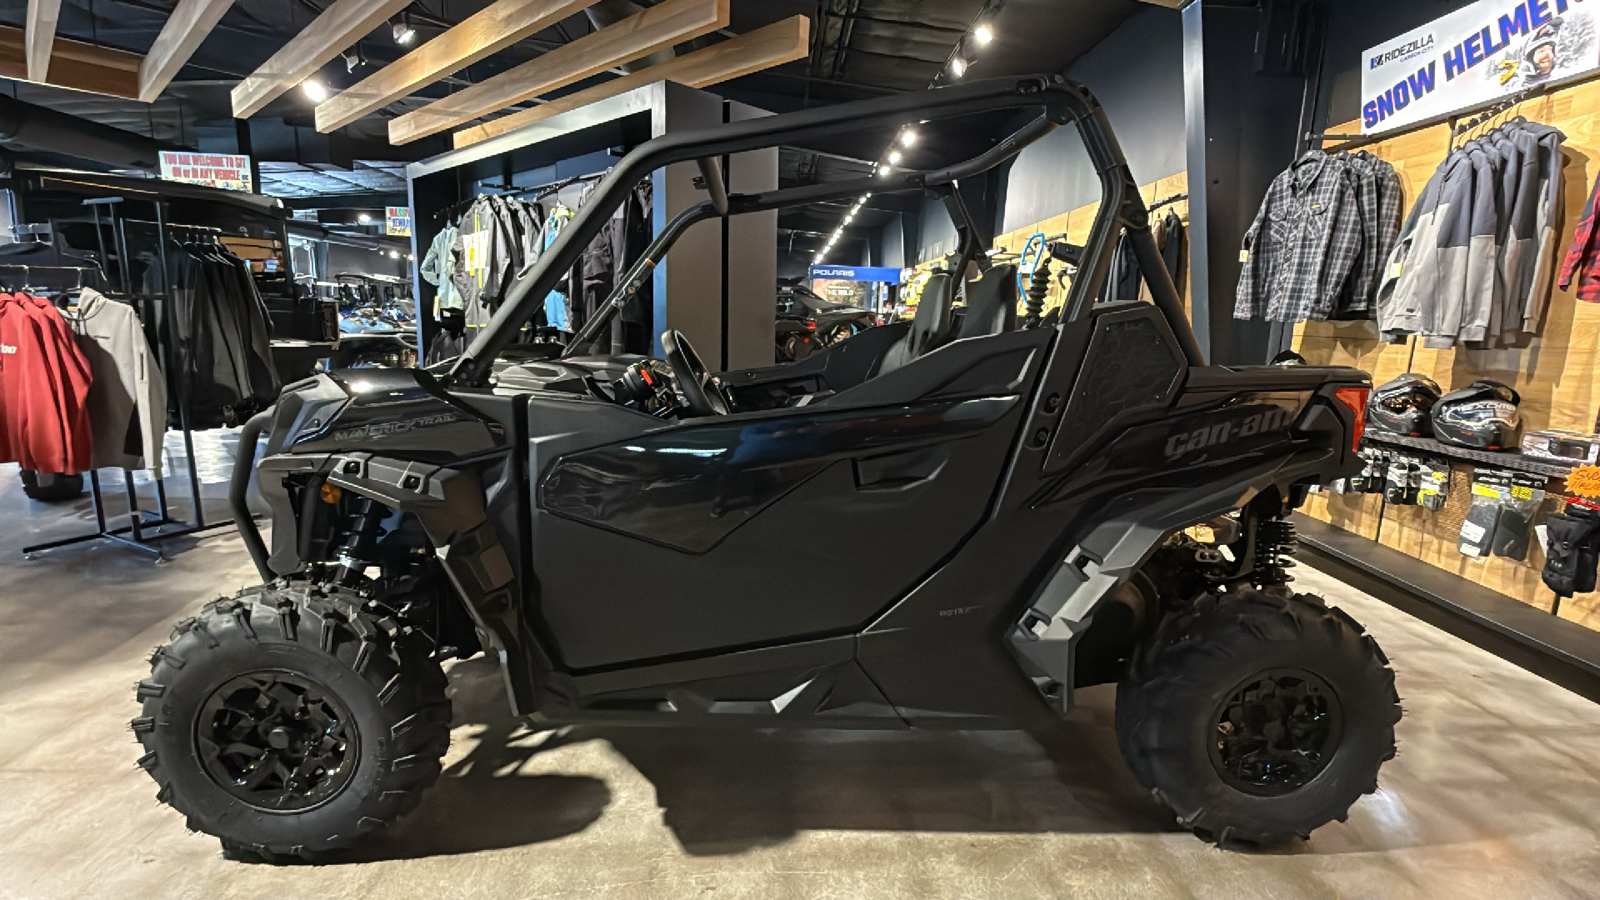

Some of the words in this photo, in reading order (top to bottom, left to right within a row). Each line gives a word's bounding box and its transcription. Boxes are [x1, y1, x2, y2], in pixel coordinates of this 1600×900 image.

[1384, 34, 1434, 63] RIDEZILLA
[1422, 46, 1434, 54] CITY
[1363, 60, 1436, 129] SNOW
[1443, 0, 1583, 82] HELME
[163, 153, 177, 165] YOU
[178, 154, 191, 165] ARE
[192, 155, 224, 167] WELCOME
[225, 156, 234, 168] TO
[235, 157, 246, 168] SIT
[200, 168, 212, 179] ANY
[214, 169, 240, 180] VEHICLE
[813, 269, 855, 278] POLARIS
[335, 420, 416, 441] MAVERICK
[418, 415, 457, 426] TRAIL
[1164, 409, 1292, 459] can-am
